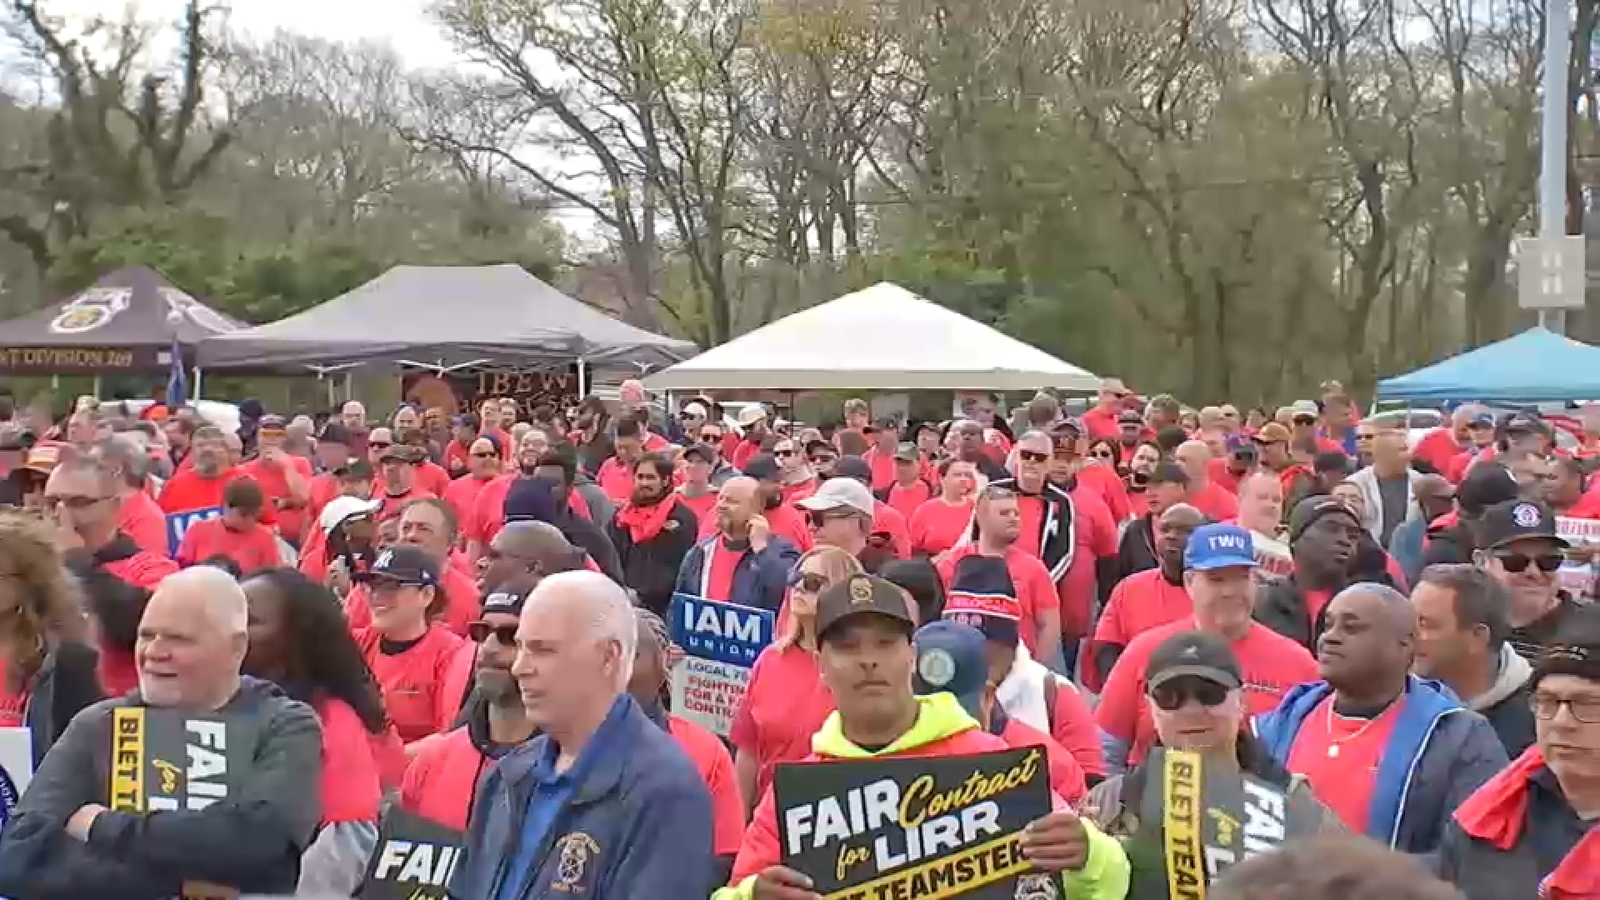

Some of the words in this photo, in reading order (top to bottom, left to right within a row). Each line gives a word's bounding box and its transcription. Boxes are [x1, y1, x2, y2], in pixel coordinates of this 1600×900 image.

[1207, 534, 1246, 552] TWU
[684, 601, 761, 643] IAM
[688, 636, 756, 658] UNION
[685, 660, 731, 679] LOCAL
[684, 687, 712, 701] FOR
[688, 675, 745, 694] FIGHTIN
[117, 717, 139, 781] BLET
[785, 778, 900, 856] FAIR
[898, 748, 1041, 829] Contract
[835, 841, 871, 881] for
[874, 800, 1001, 872] LIRR
